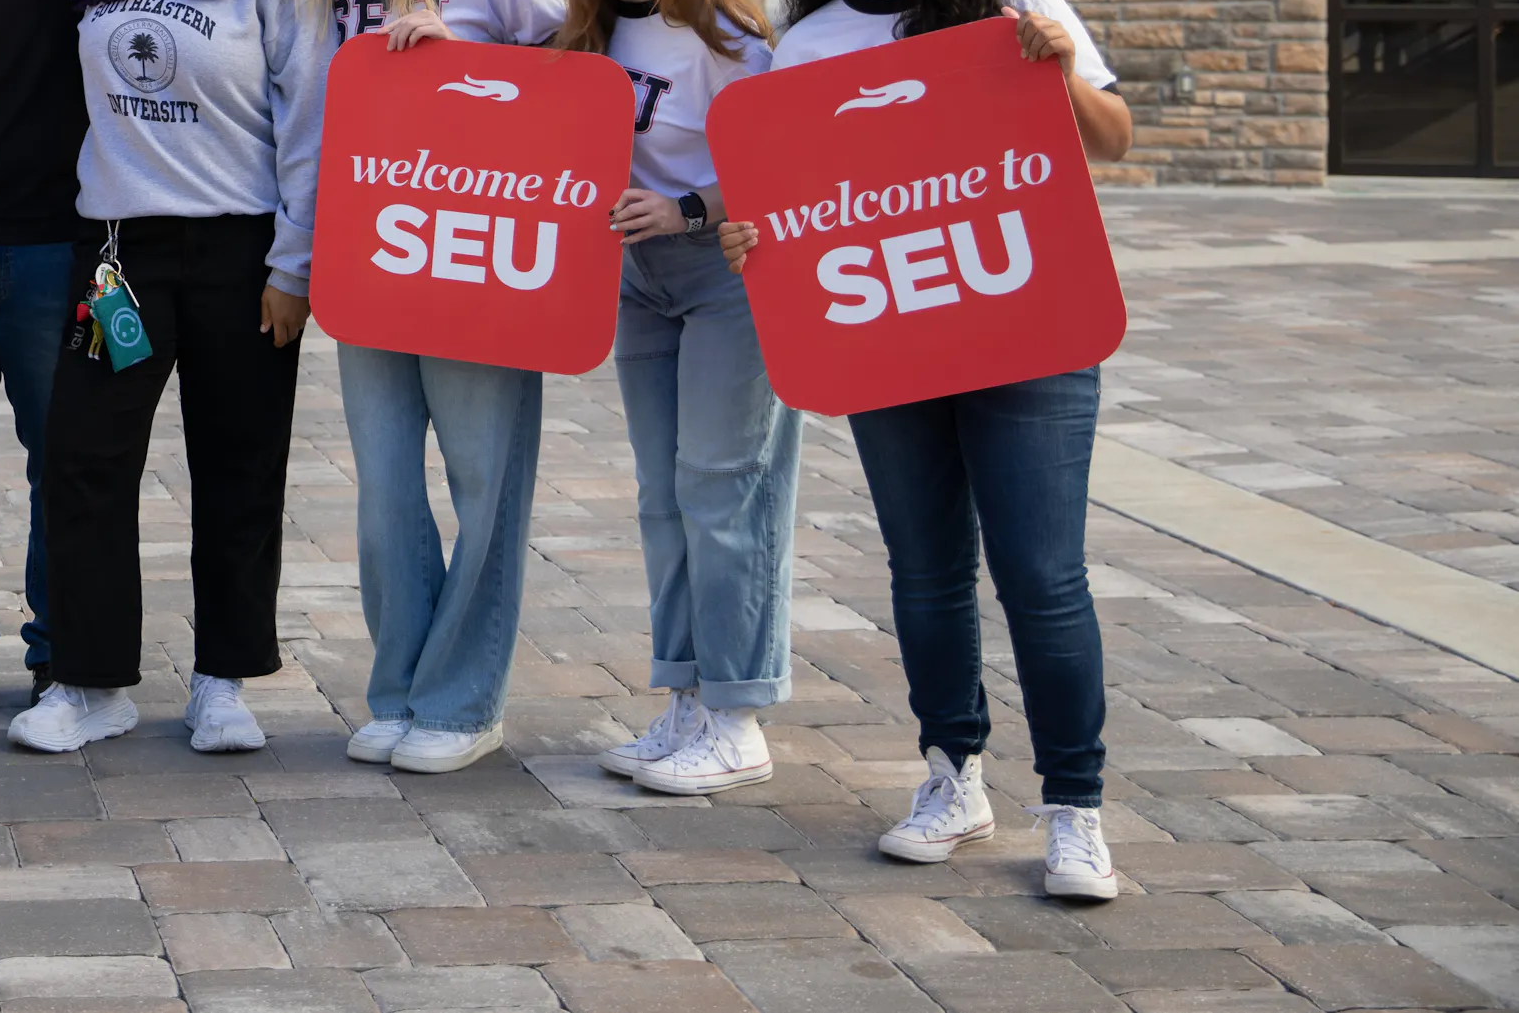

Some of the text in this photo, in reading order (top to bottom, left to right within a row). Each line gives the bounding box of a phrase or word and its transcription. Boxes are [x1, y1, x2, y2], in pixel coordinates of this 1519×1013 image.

[106, 93, 199, 123] UNIVERSITY
[350, 149, 598, 208] welcome to
[764, 148, 1052, 242] welcome to
[370, 203, 559, 290] SEU
[816, 210, 1033, 325] SEU
